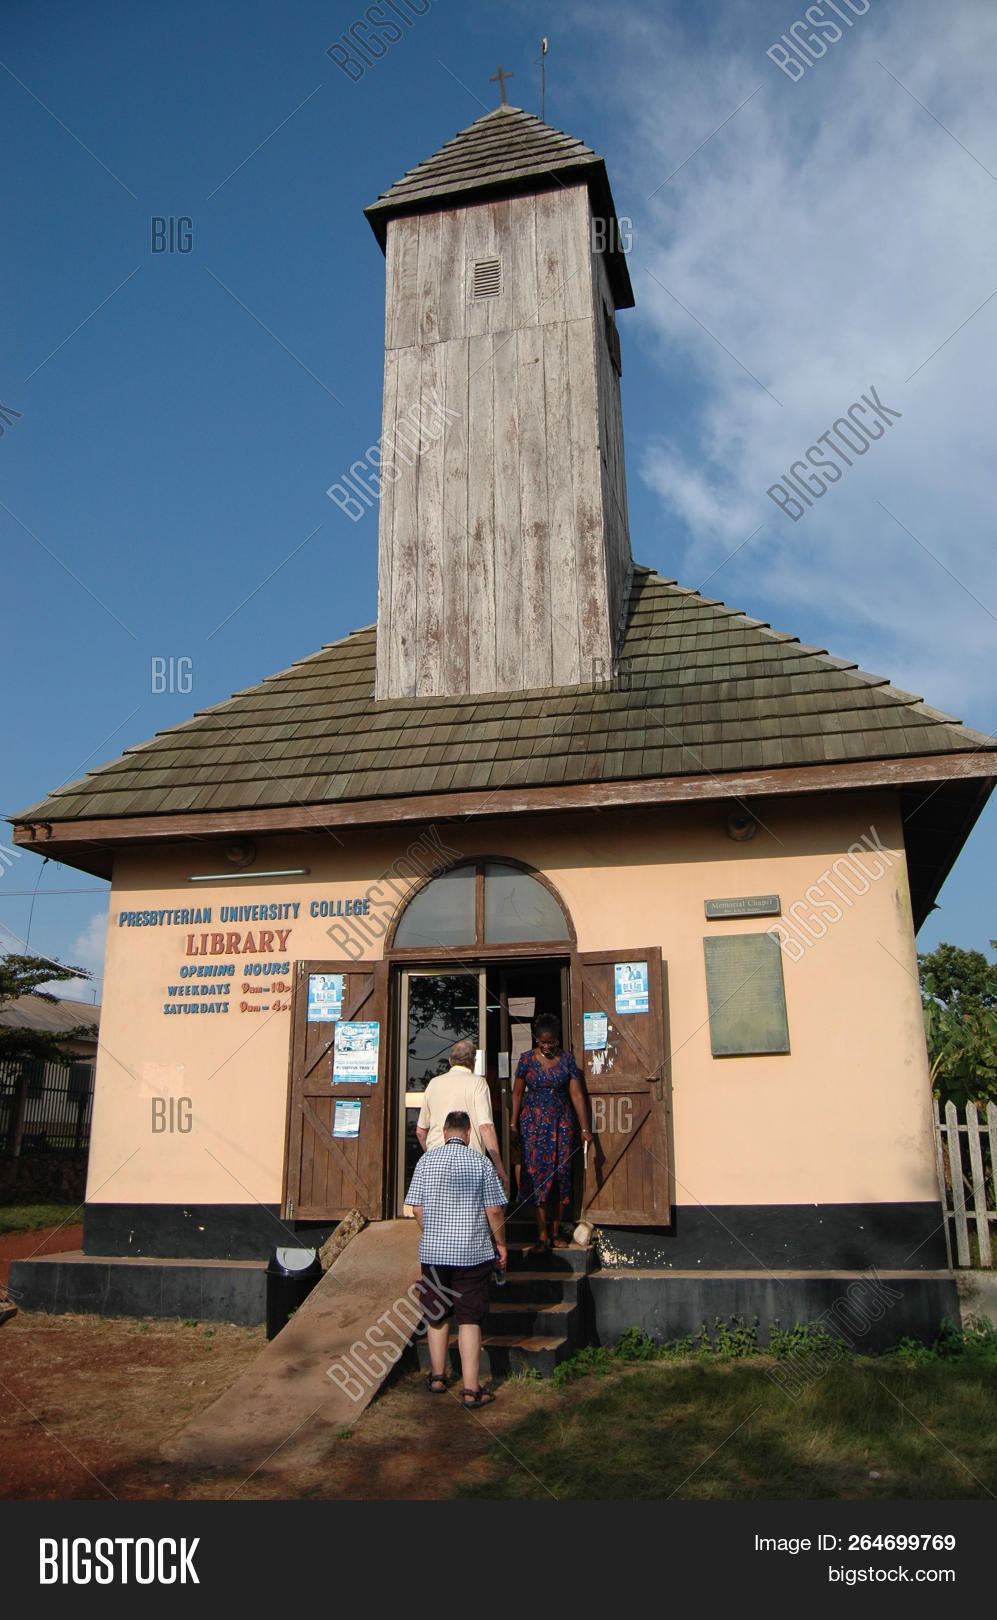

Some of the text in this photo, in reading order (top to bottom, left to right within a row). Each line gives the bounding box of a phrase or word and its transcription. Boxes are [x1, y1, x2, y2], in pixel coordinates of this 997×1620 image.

[119, 898, 370, 927] PRESBYTERIAN UNIVERSITY COLLEGE
[186, 929, 292, 956] LIBRARY
[179, 961, 290, 978] OPENING HOURS
[168, 983, 231, 996] WEEKDAYS
[163, 1002, 230, 1015] SATURDAYS
